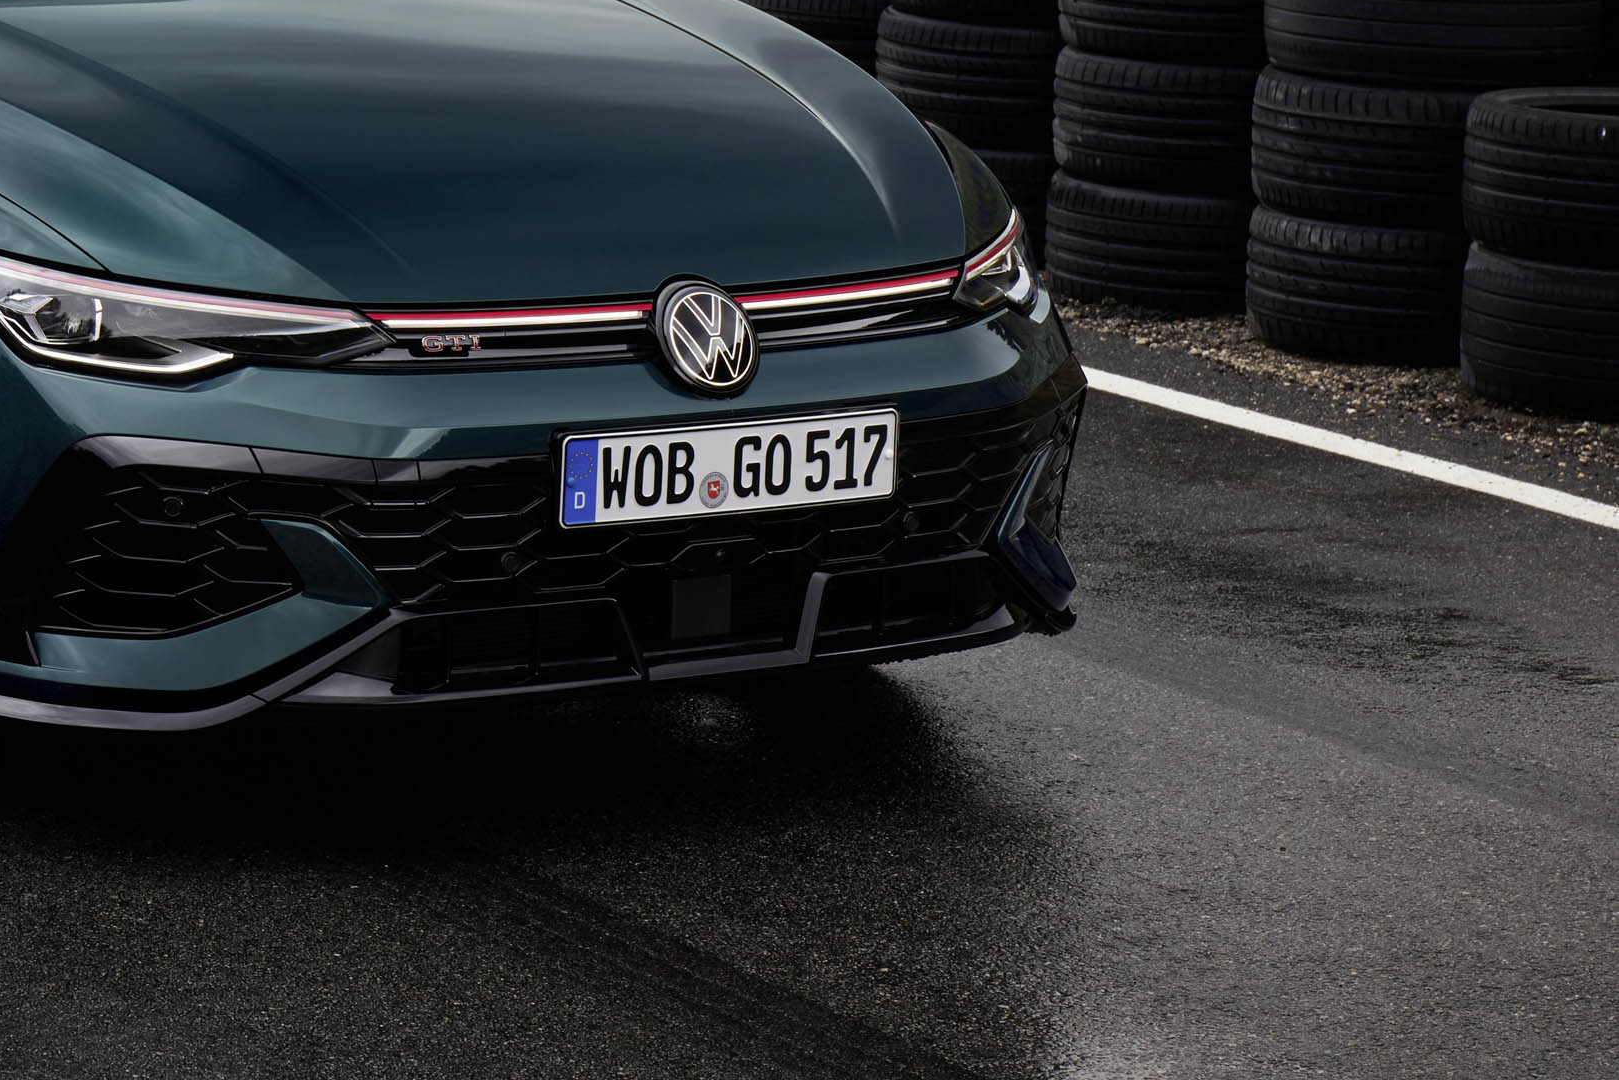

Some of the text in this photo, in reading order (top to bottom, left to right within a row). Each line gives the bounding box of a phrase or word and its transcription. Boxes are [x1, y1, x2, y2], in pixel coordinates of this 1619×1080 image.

[421, 334, 482, 353] GTI
[573, 491, 586, 510] D
[602, 440, 696, 510] WOB
[732, 433, 793, 499] GO
[804, 424, 889, 493] 517
